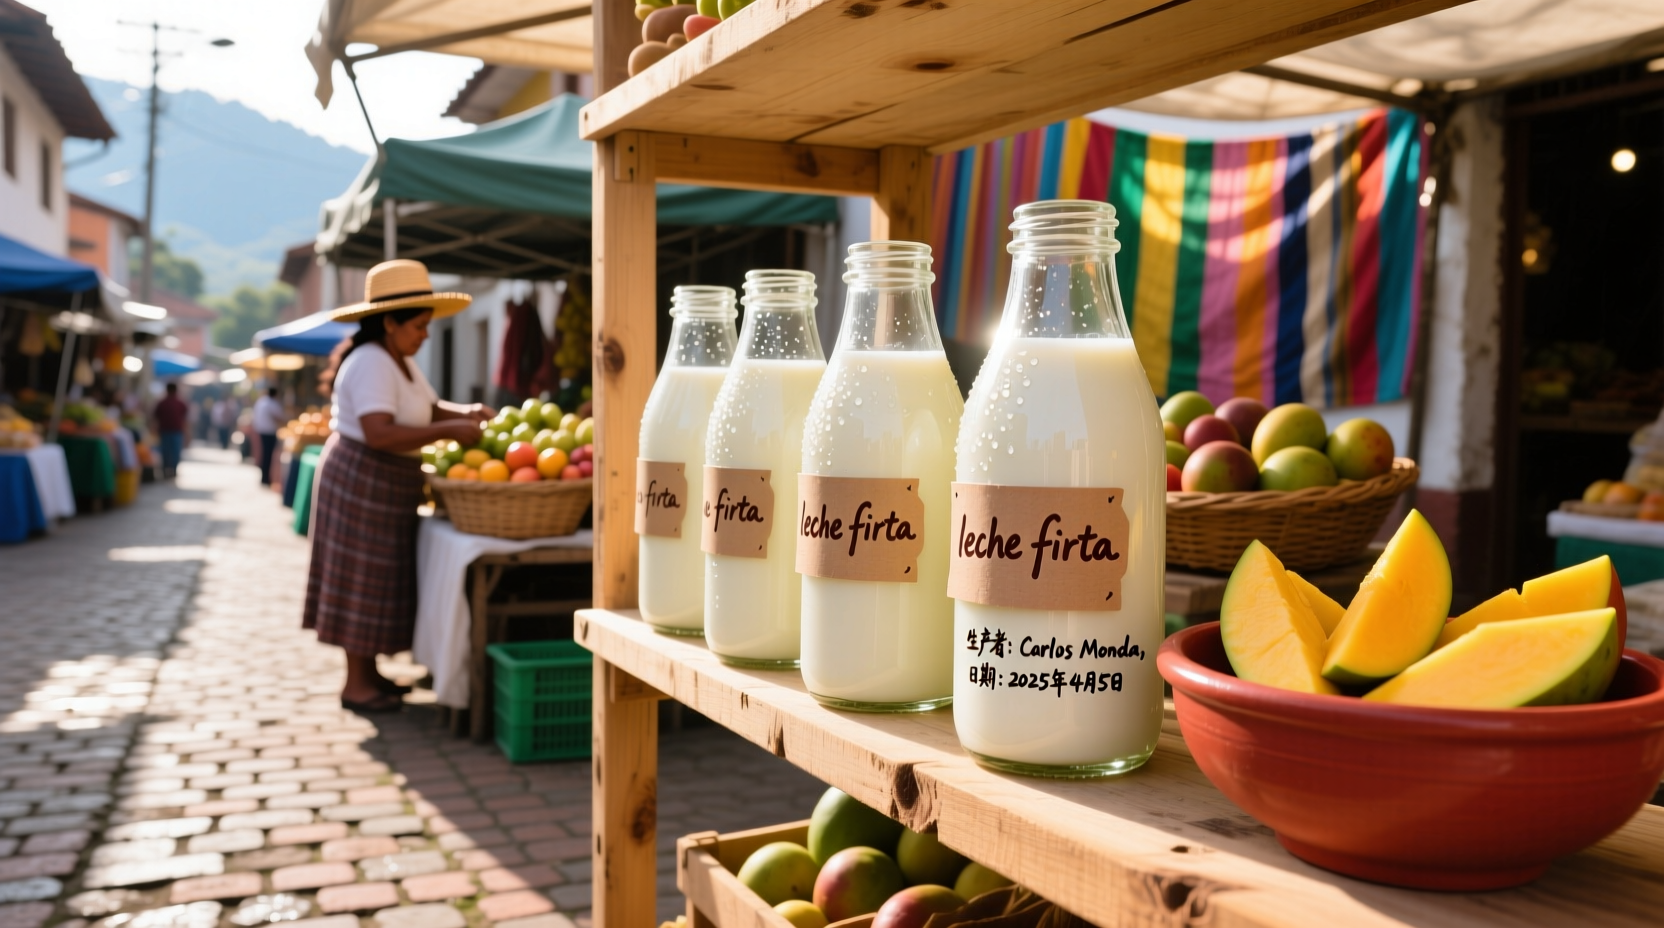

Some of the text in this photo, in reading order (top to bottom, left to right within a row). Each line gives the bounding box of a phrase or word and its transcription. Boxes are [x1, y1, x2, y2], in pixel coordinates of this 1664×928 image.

[645, 480, 681, 518] firta
[714, 487, 764, 533] firta
[800, 500, 917, 557] leche firta
[958, 513, 1120, 580] leche firta
[966, 627, 1145, 661] 生产者: Carlos Monda,
